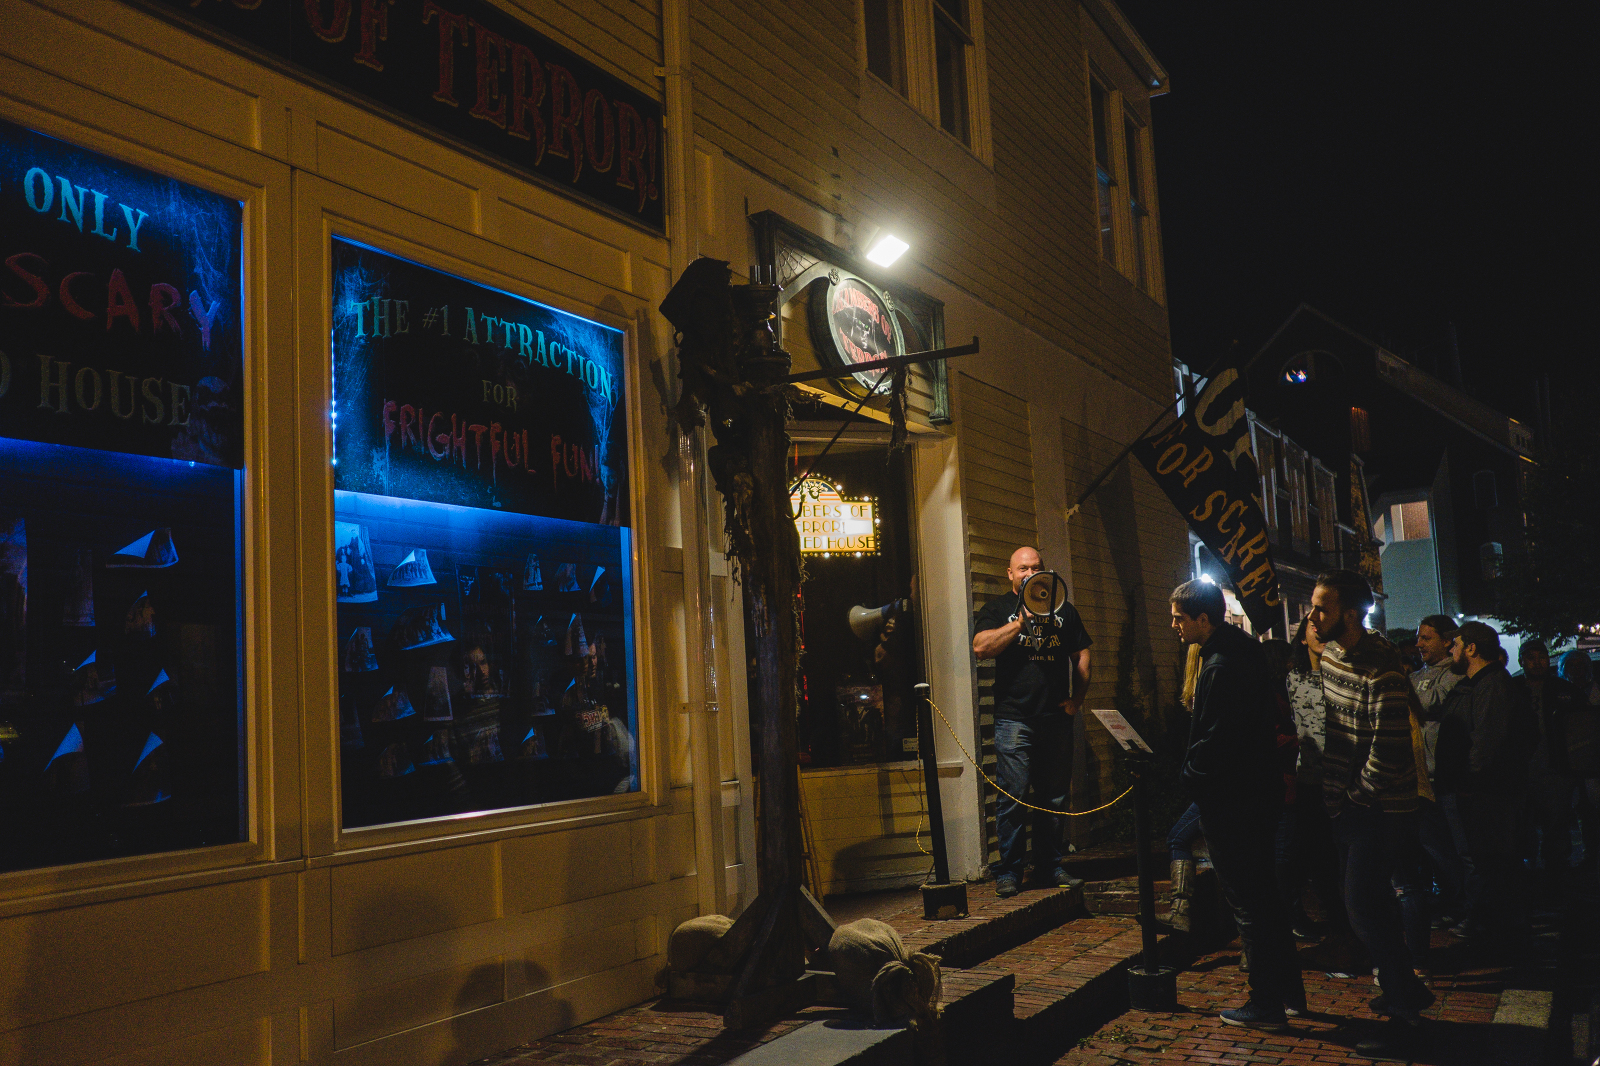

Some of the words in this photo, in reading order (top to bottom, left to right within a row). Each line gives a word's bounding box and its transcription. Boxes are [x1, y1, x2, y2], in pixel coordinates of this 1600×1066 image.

[423, 0, 658, 213] TERROR!
[23, 166, 149, 253] ONLY
[1, 252, 220, 350] SCARY
[36, 354, 191, 427] HOUSE
[350, 296, 410, 339] THE
[421, 304, 451, 337] #1
[463, 306, 613, 406] ATTRACTION
[482, 379, 518, 413] FOR
[382, 398, 537, 489] FRIGHTFUL
[1149, 418, 1214, 489] FOR
[800, 504, 842, 518] BERS
[850, 504, 869, 518] OF
[827, 536, 875, 550] HOUSE
